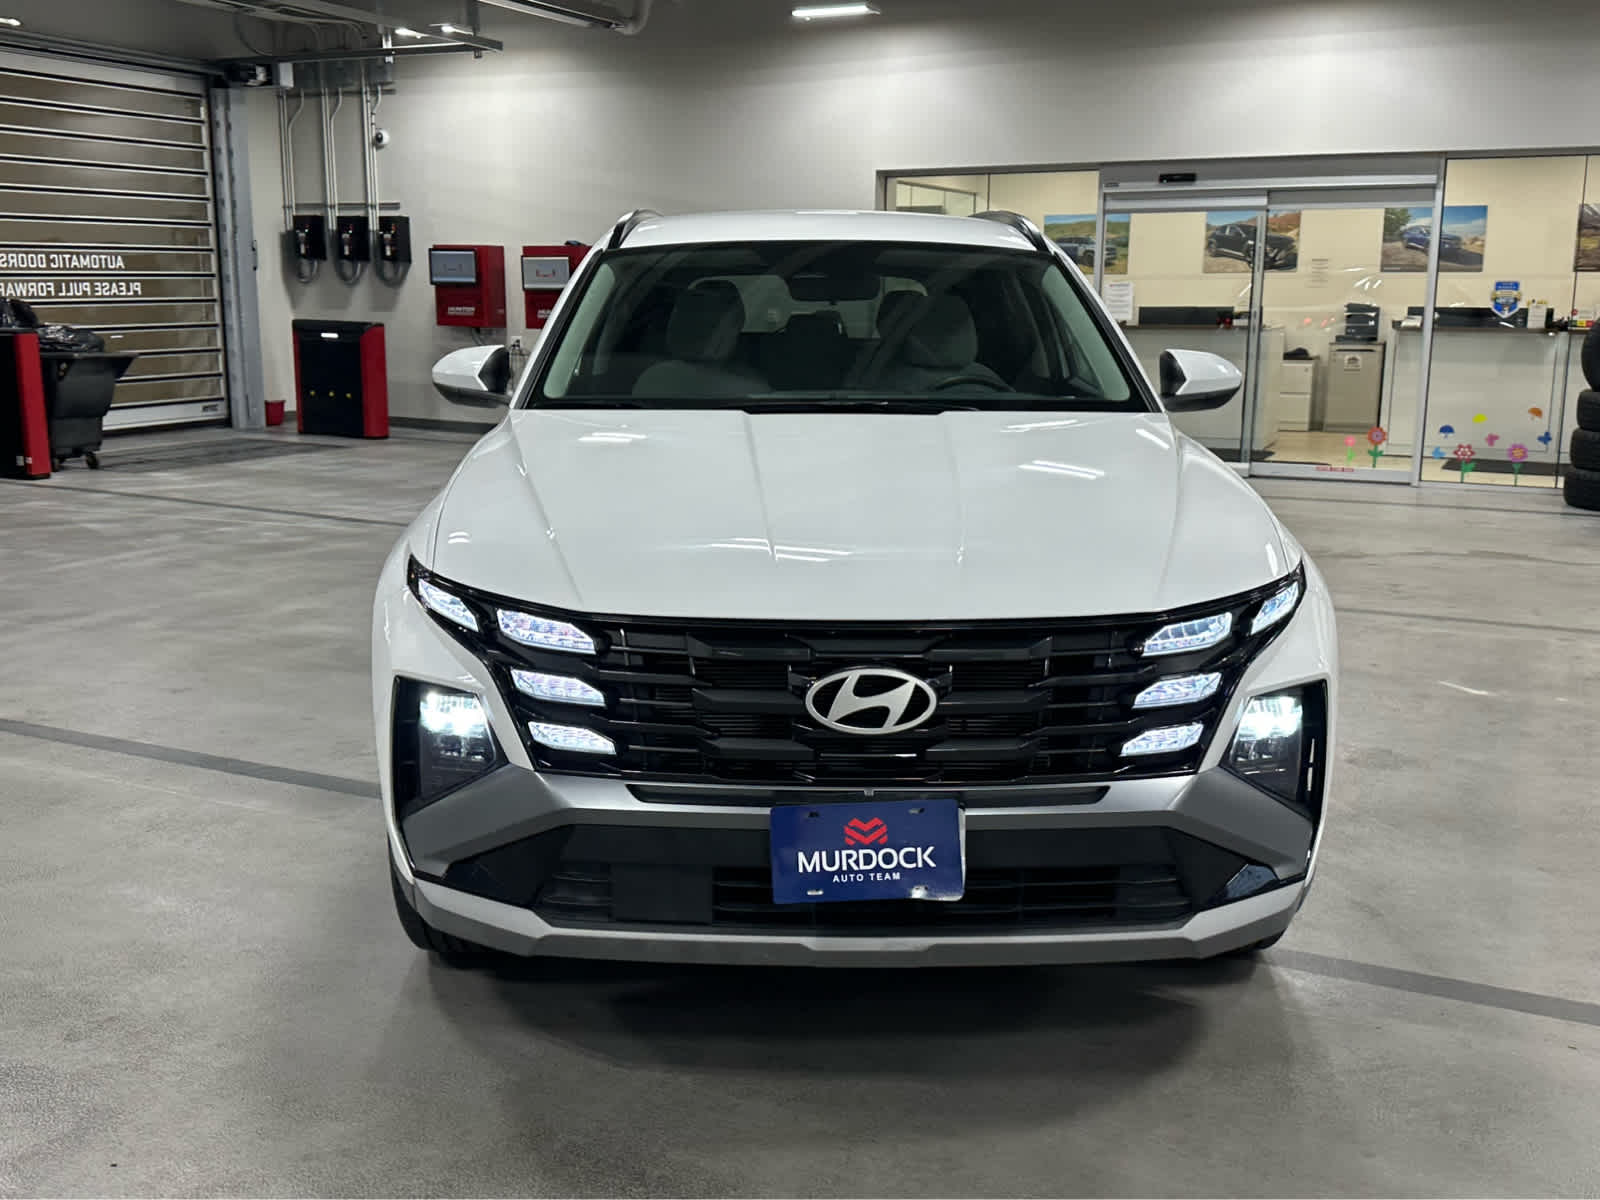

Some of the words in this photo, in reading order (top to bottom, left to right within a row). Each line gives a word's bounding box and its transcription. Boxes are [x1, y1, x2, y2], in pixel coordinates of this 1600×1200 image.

[797, 846, 937, 873] MURDOCK
[832, 873, 865, 883] AUTO
[869, 871, 901, 881] TEAM
